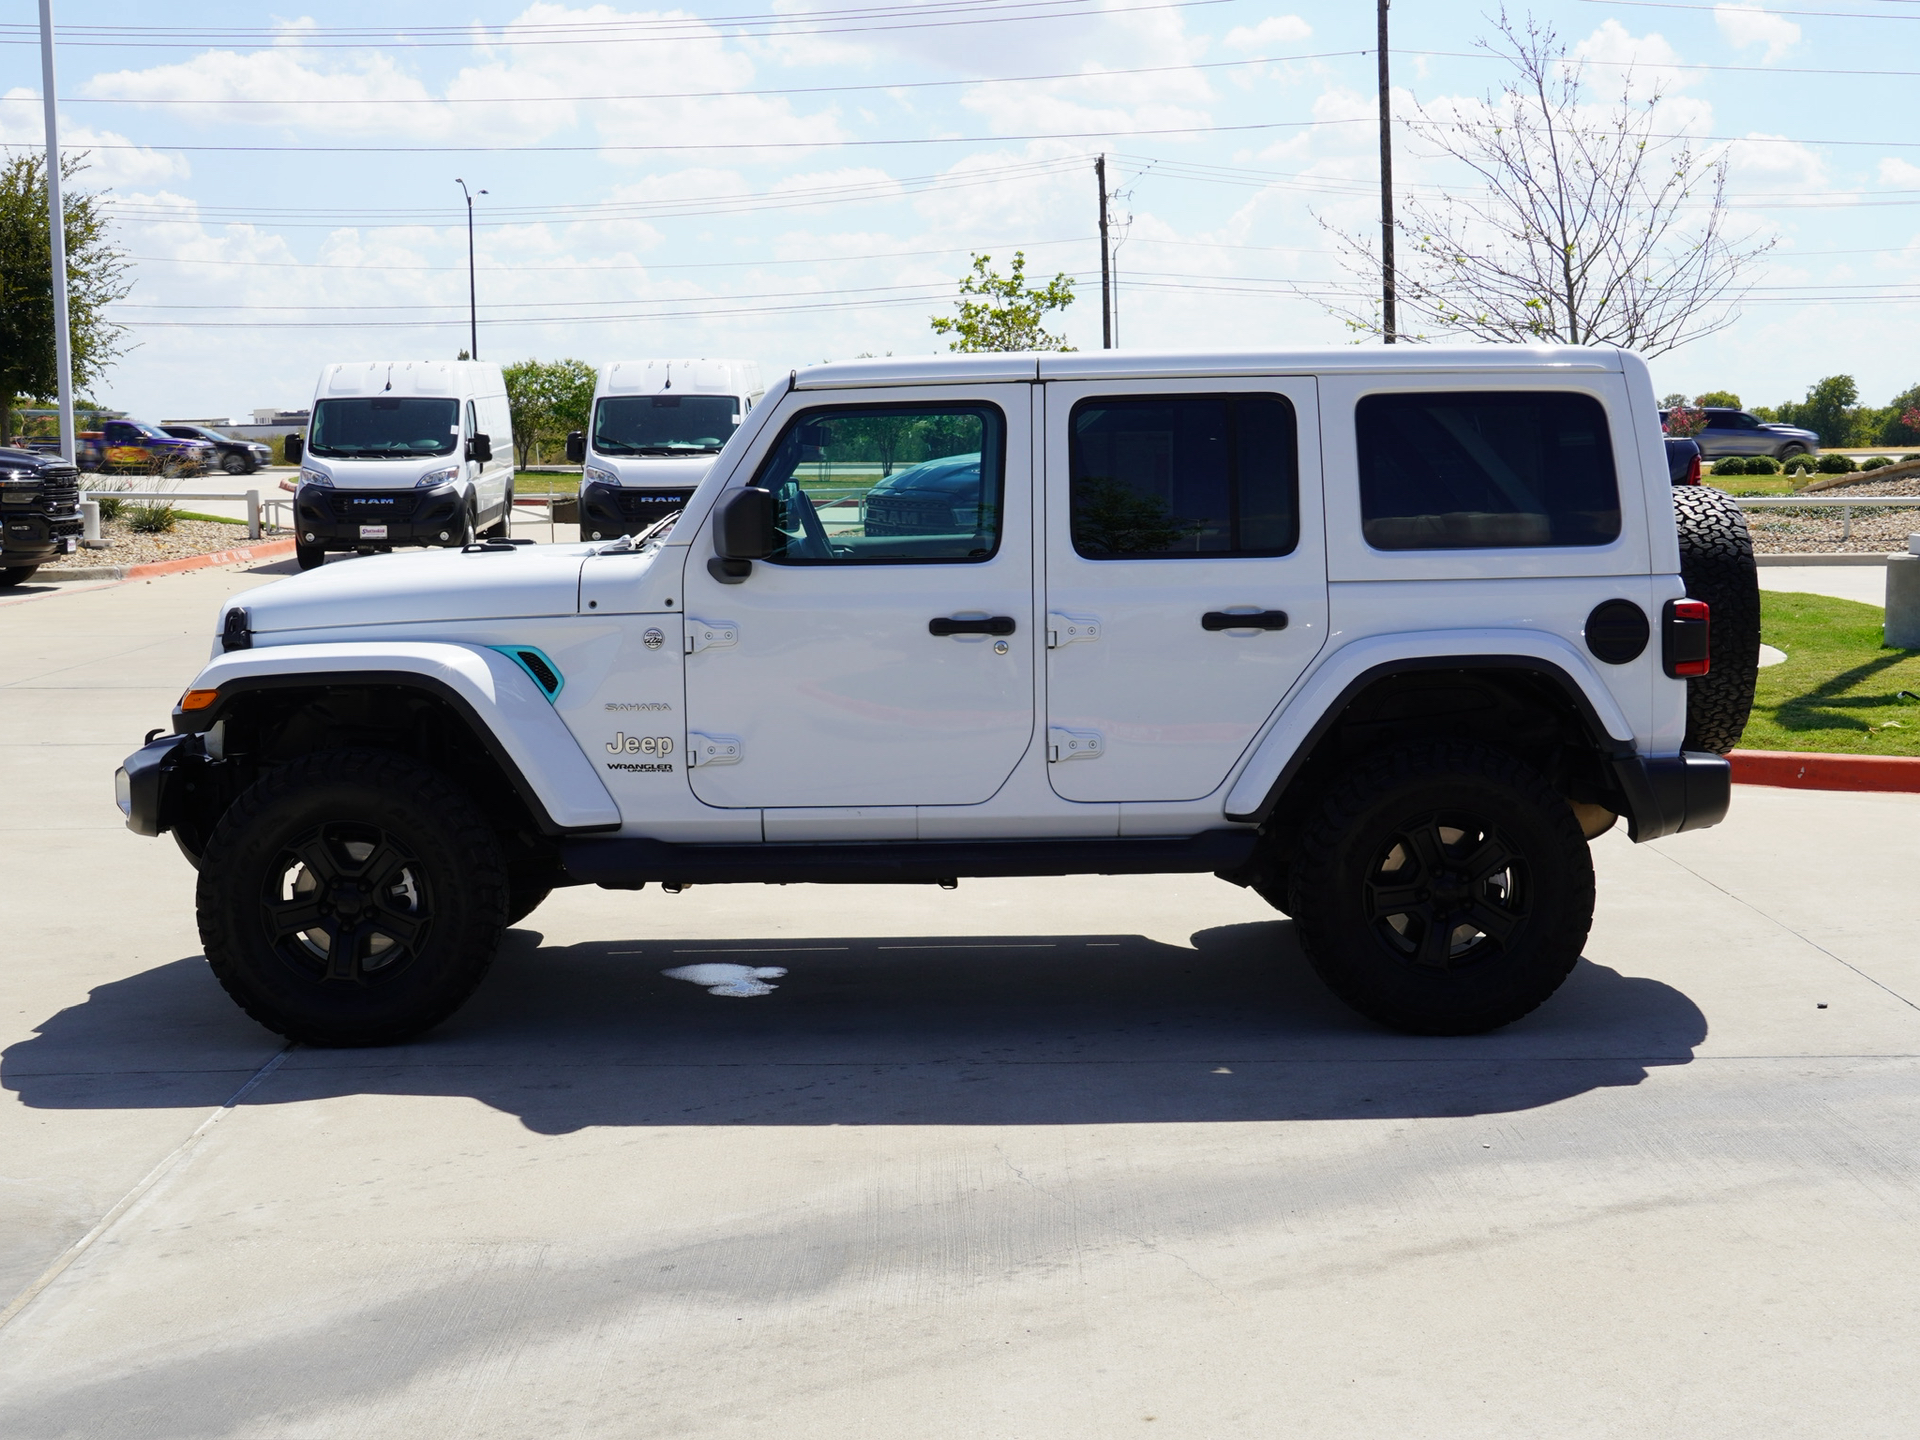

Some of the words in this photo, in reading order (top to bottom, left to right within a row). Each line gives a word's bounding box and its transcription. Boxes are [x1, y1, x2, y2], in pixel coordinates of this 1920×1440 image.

[876, 510, 918, 525] RAM
[605, 703, 671, 711] SAHARA
[606, 732, 673, 758] Jeep
